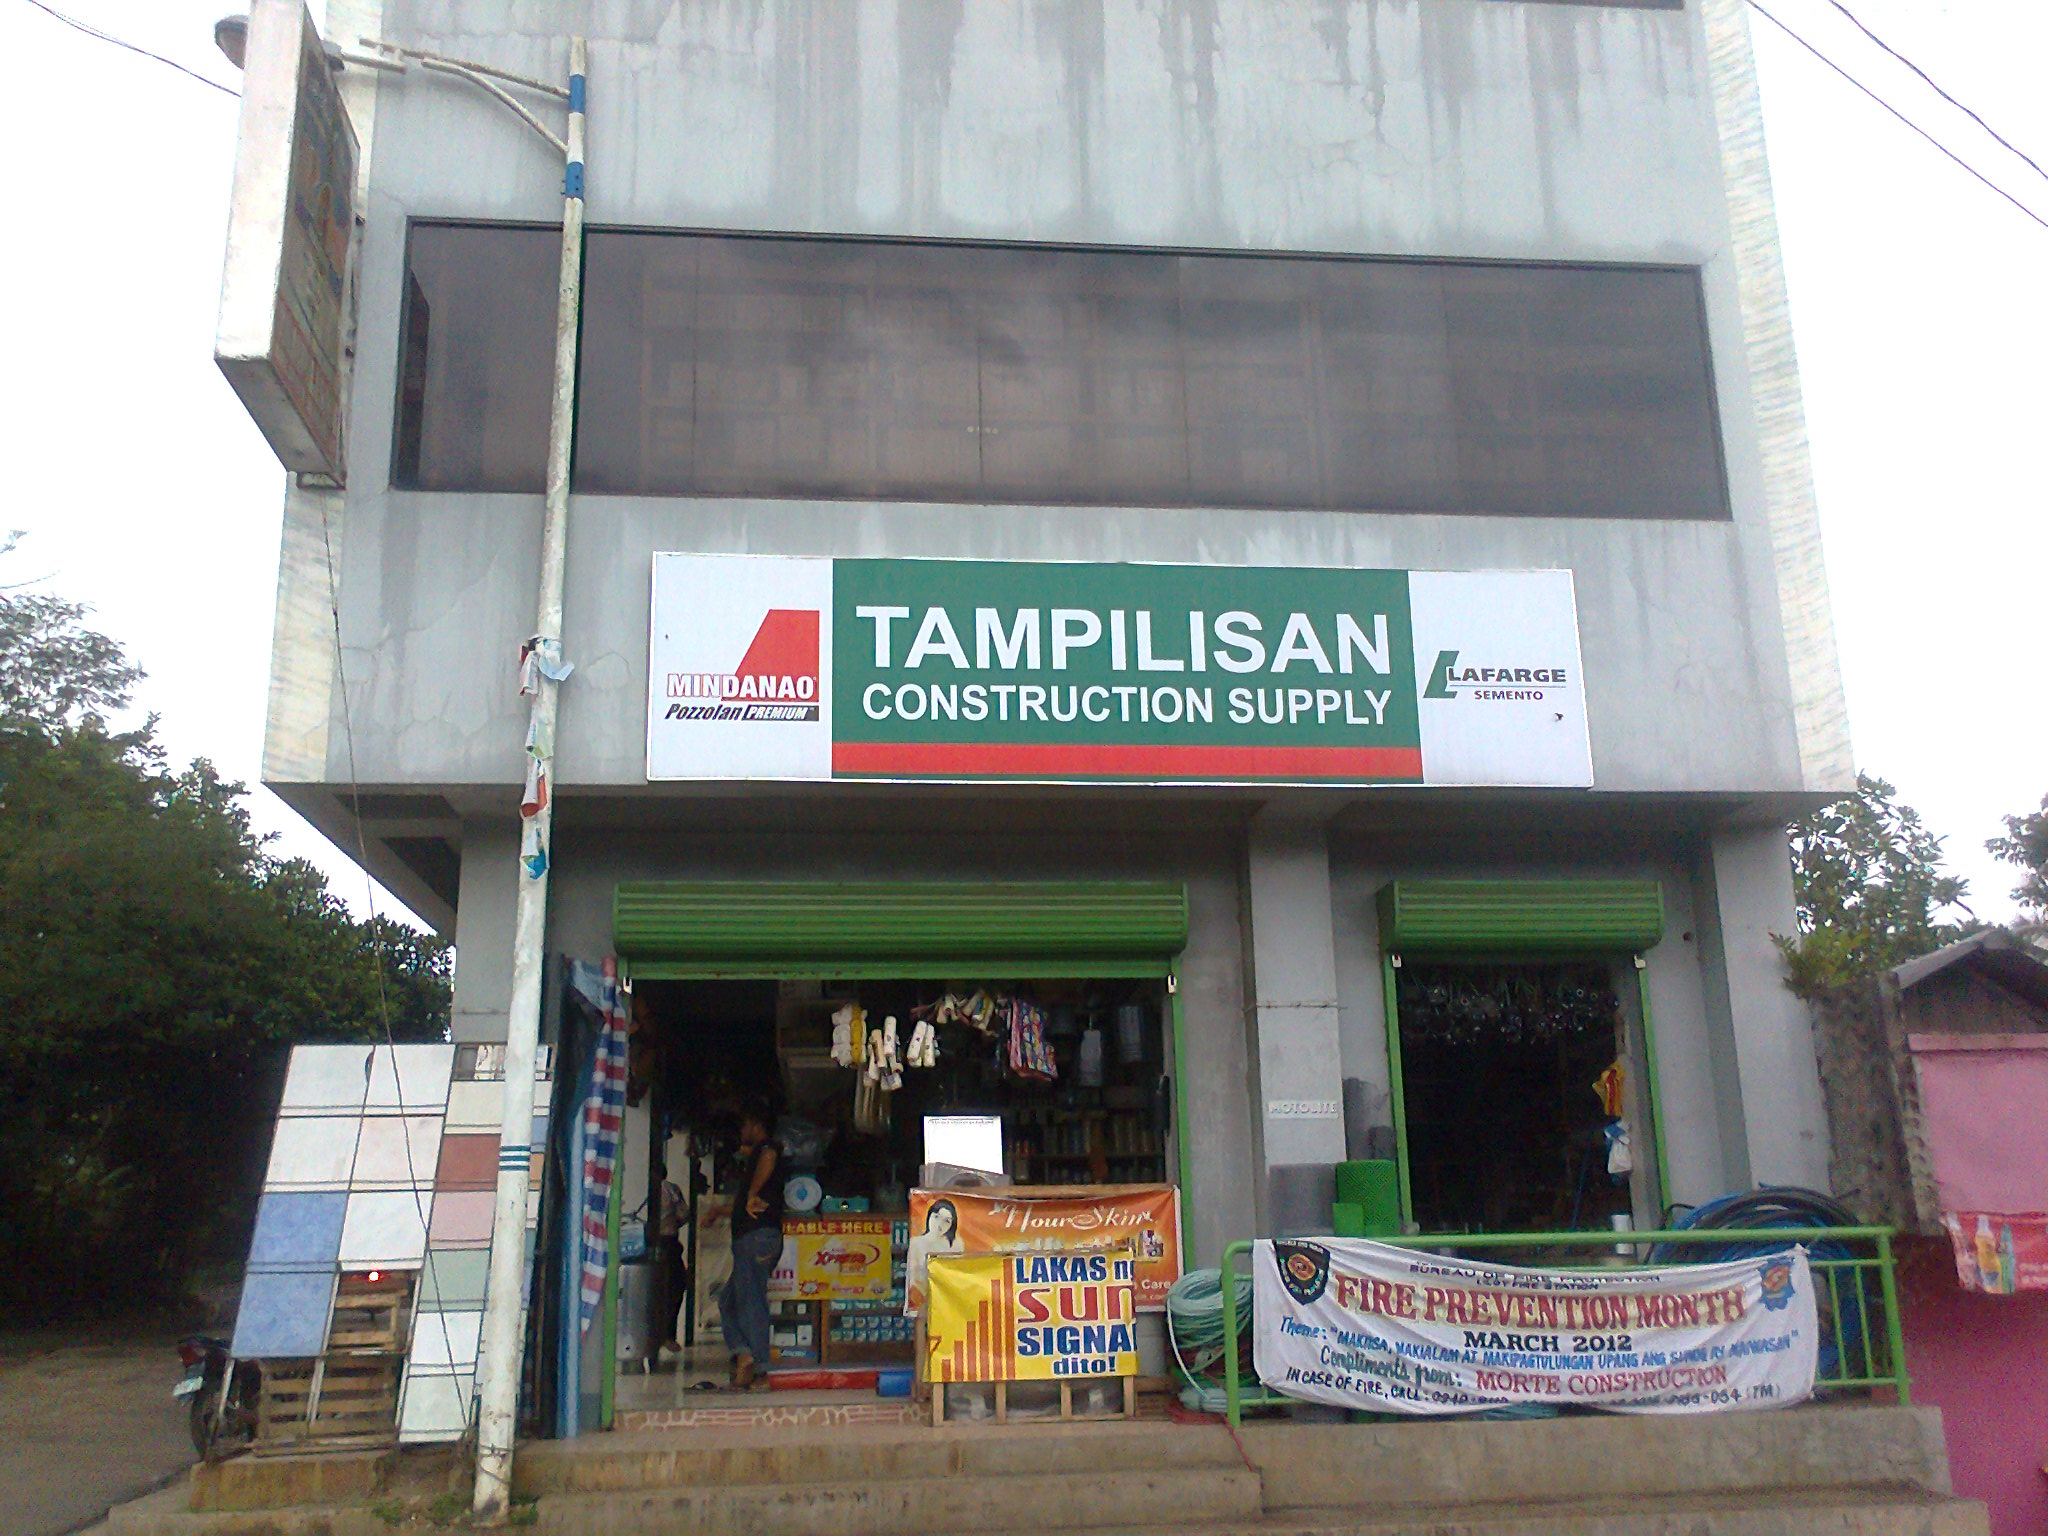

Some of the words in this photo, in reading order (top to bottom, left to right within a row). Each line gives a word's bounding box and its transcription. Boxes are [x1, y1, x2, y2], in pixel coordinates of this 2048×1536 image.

[856, 606, 1391, 674] TAMPILISAN
[666, 673, 815, 699] MINDANAO
[1448, 667, 1567, 683] LAFARGE
[862, 683, 1213, 723] CONSTRUCTION
[1228, 687, 1392, 725] SUPPLY
[1474, 690, 1544, 701] SEMENTO
[665, 703, 744, 721] Pozzolan
[746, 706, 809, 720] PREMIUM
[841, 1220, 884, 1233] HERE
[1016, 1256, 1107, 1284] LAKAS
[1334, 1274, 1418, 1320] FIRE
[1423, 1286, 1628, 1331] PREVENTION
[1634, 1285, 1748, 1329] MONTH
[1463, 1330, 1560, 1353] MARCH
[1572, 1334, 1632, 1353] 2012
[1053, 1355, 1116, 1376] dito!
[1320, 1344, 1411, 1380] Compliments
[1415, 1363, 1463, 1388] from:
[1461, 1348, 1479, 1364] AT
[1597, 1352, 1639, 1369] UPANG
[1286, 1366, 1301, 1382] IN
[1301, 1370, 1334, 1388] CASE
[1335, 1376, 1353, 1390] OF
[1475, 1368, 1561, 1395] MORTE
[1568, 1364, 1728, 1396] CONSTRUCTION
